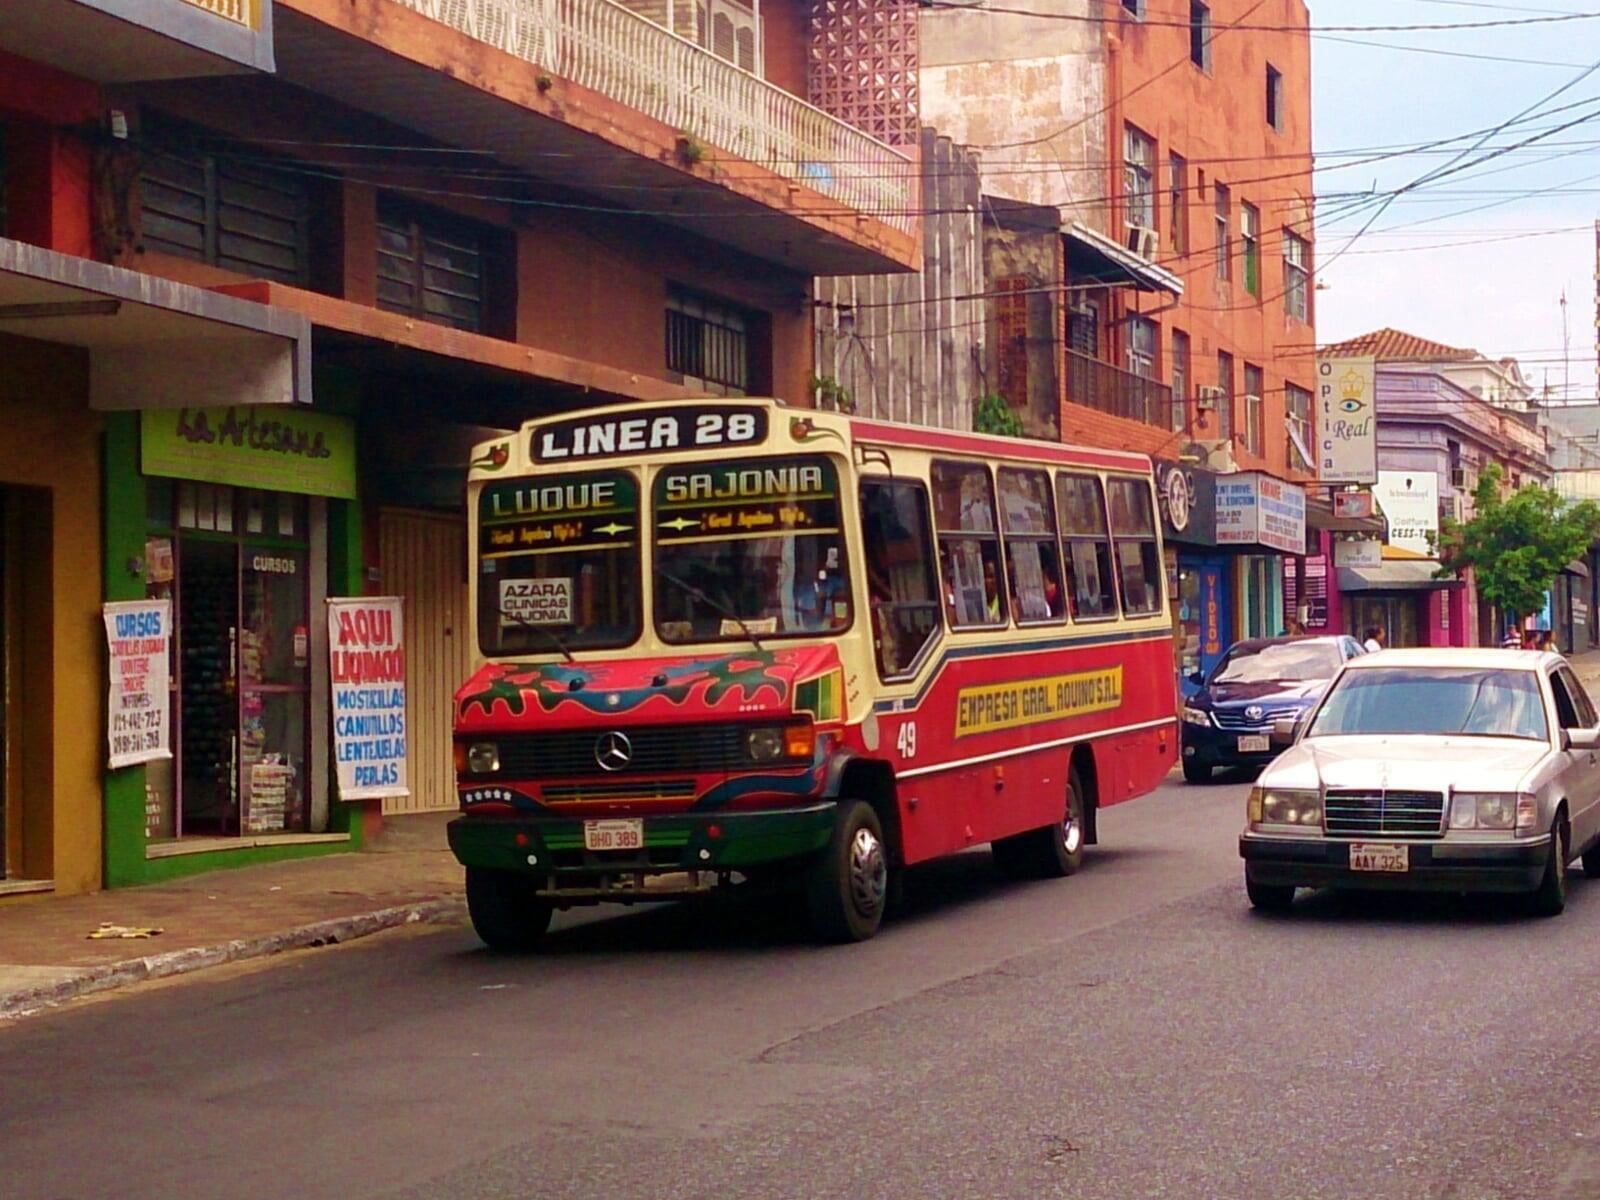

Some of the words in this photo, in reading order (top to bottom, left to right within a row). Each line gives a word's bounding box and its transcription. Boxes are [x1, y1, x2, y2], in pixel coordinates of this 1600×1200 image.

[541, 416, 679, 458] LINEA
[695, 413, 755, 445] 28
[1333, 416, 1373, 441] Real
[666, 466, 823, 501] SAJONIA
[253, 555, 296, 574] CURSOS
[503, 597, 568, 610] CLINICAS
[505, 584, 567, 598] AZARA
[115, 611, 161, 637] CURSOS
[505, 609, 568, 622] SAJONIA
[337, 608, 393, 649] AQUI
[959, 690, 1017, 728] EMPRESA
[336, 713, 404, 737] CANUTILLOS
[896, 721, 916, 758] 49
[354, 762, 398, 787] PERLAS
[615, 831, 638, 847] 389
[1355, 854, 1377, 868] AAY
[1381, 855, 1404, 870] 325
